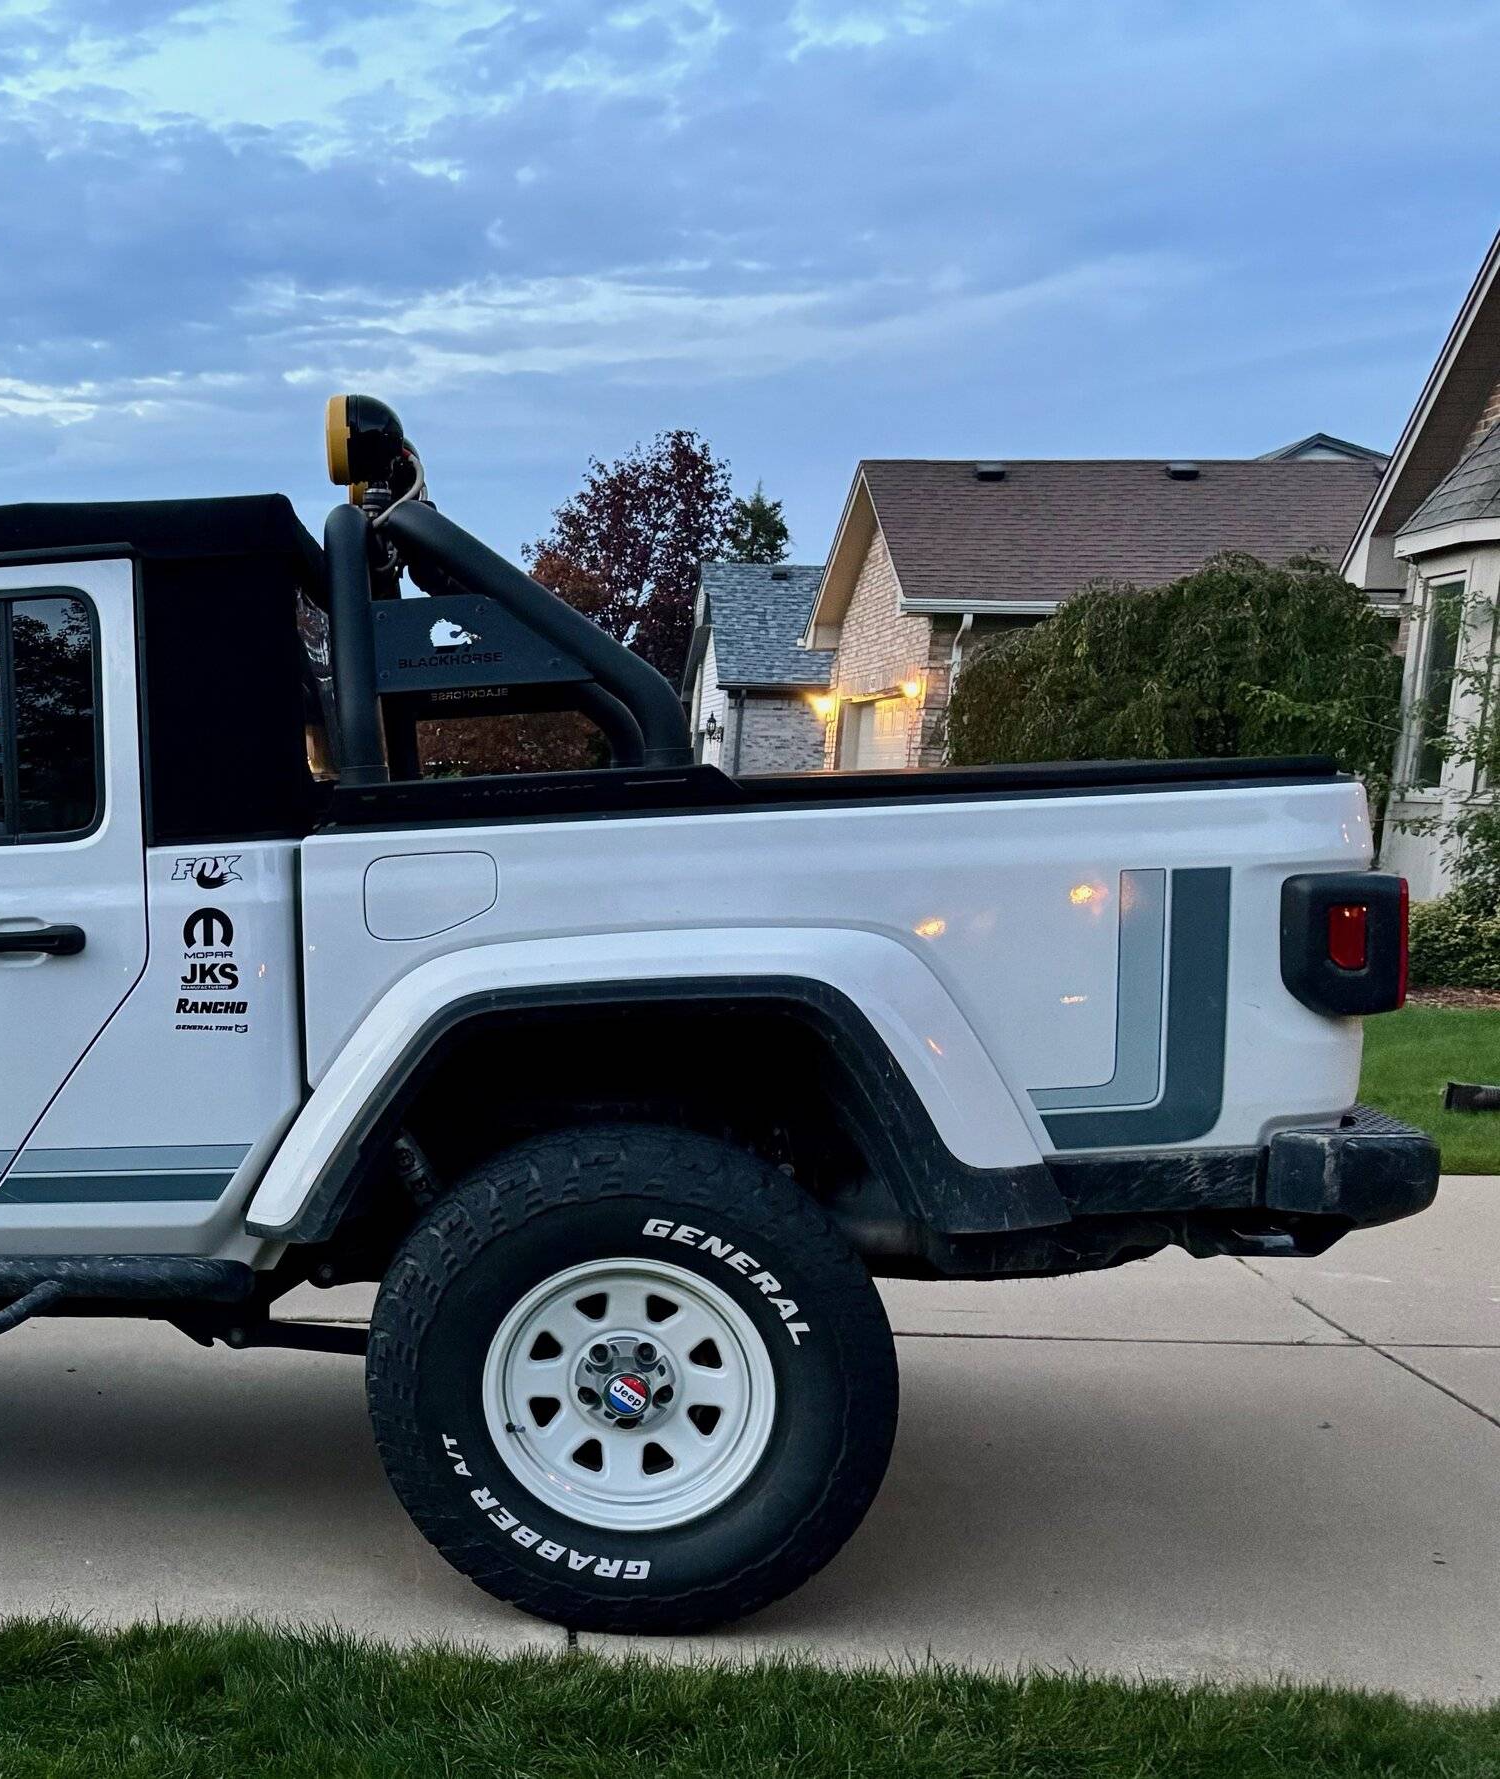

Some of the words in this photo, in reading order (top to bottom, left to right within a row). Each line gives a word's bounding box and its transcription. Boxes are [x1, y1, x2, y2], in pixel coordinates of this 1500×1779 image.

[398, 652, 504, 669] BLACKHORSE
[171, 855, 243, 889] FOX
[184, 951, 234, 960] MOPAR
[181, 963, 239, 990] JKS
[176, 998, 248, 1014] RANCHO
[642, 1218, 811, 1346] GENERAL
[613, 1385, 642, 1407] Jeep
[441, 1433, 473, 1477] A/T
[470, 1486, 651, 1580] GRABBER
